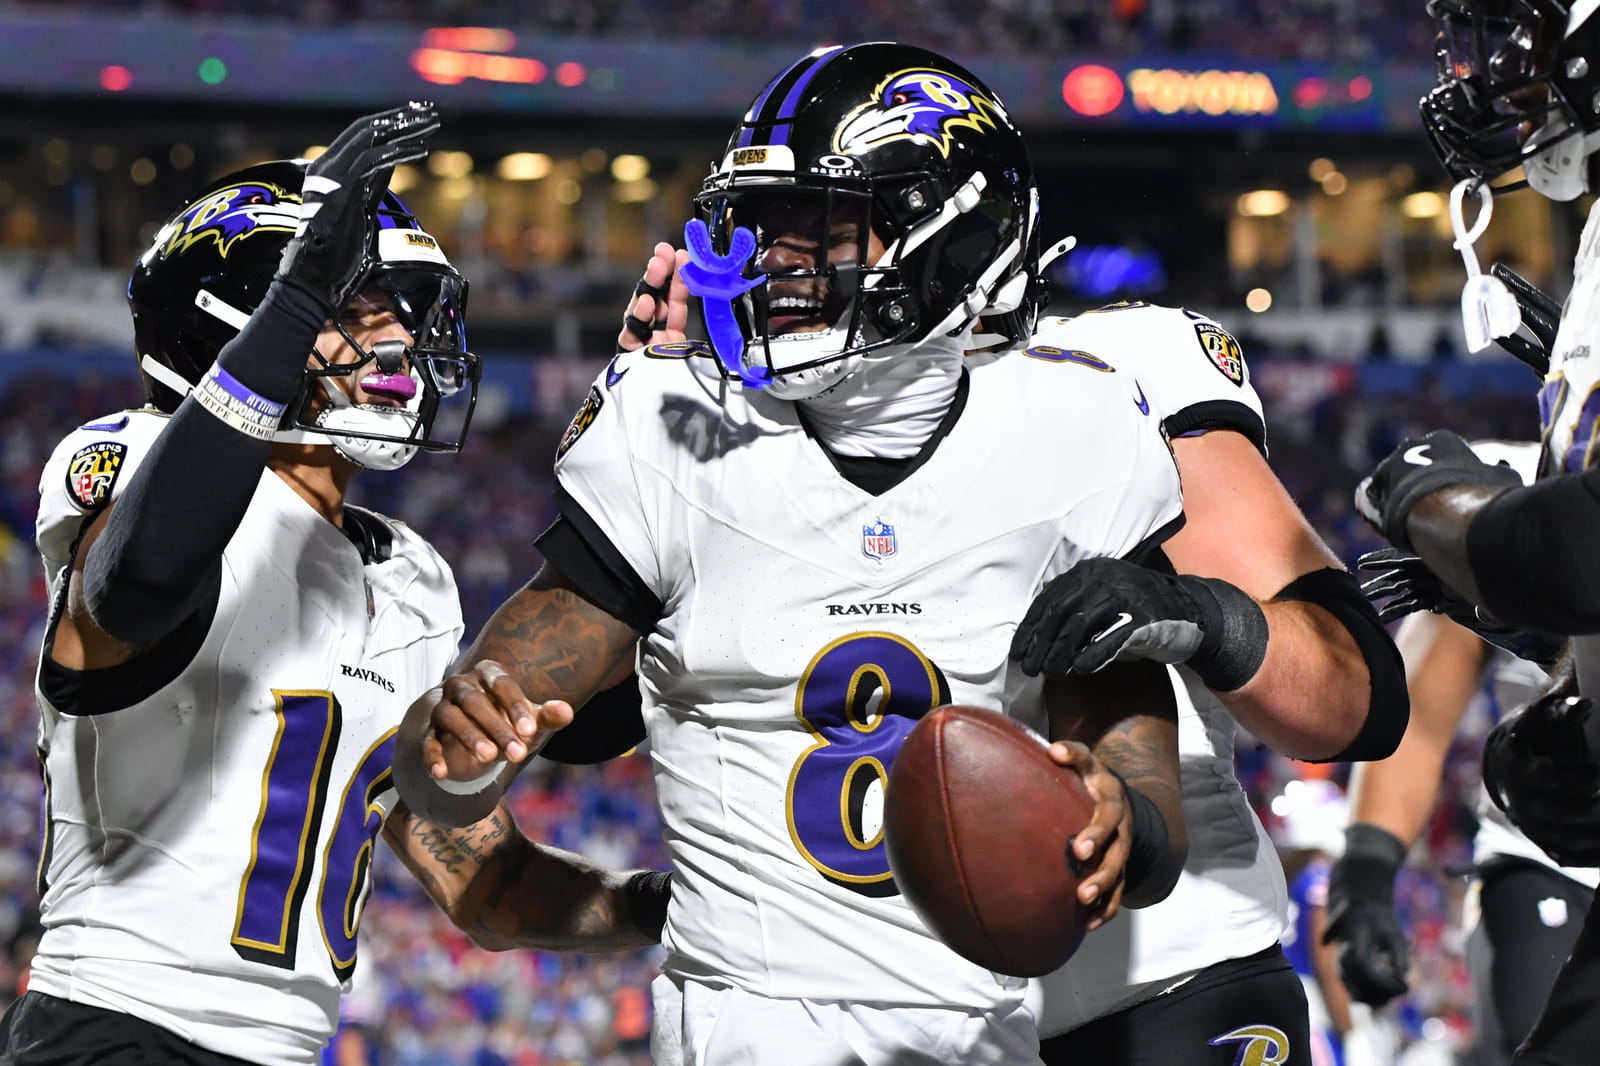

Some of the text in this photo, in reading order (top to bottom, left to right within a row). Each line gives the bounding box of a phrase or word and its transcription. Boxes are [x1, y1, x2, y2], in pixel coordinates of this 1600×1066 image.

[202, 395, 231, 421] HYPE
[228, 397, 262, 425] WORK
[76, 443, 122, 459] RAVENS
[867, 537, 893, 555] NFL
[825, 603, 923, 616] RAVENS
[340, 664, 395, 693] RAVENS
[785, 630, 953, 898] 8
[231, 688, 399, 984] 16
